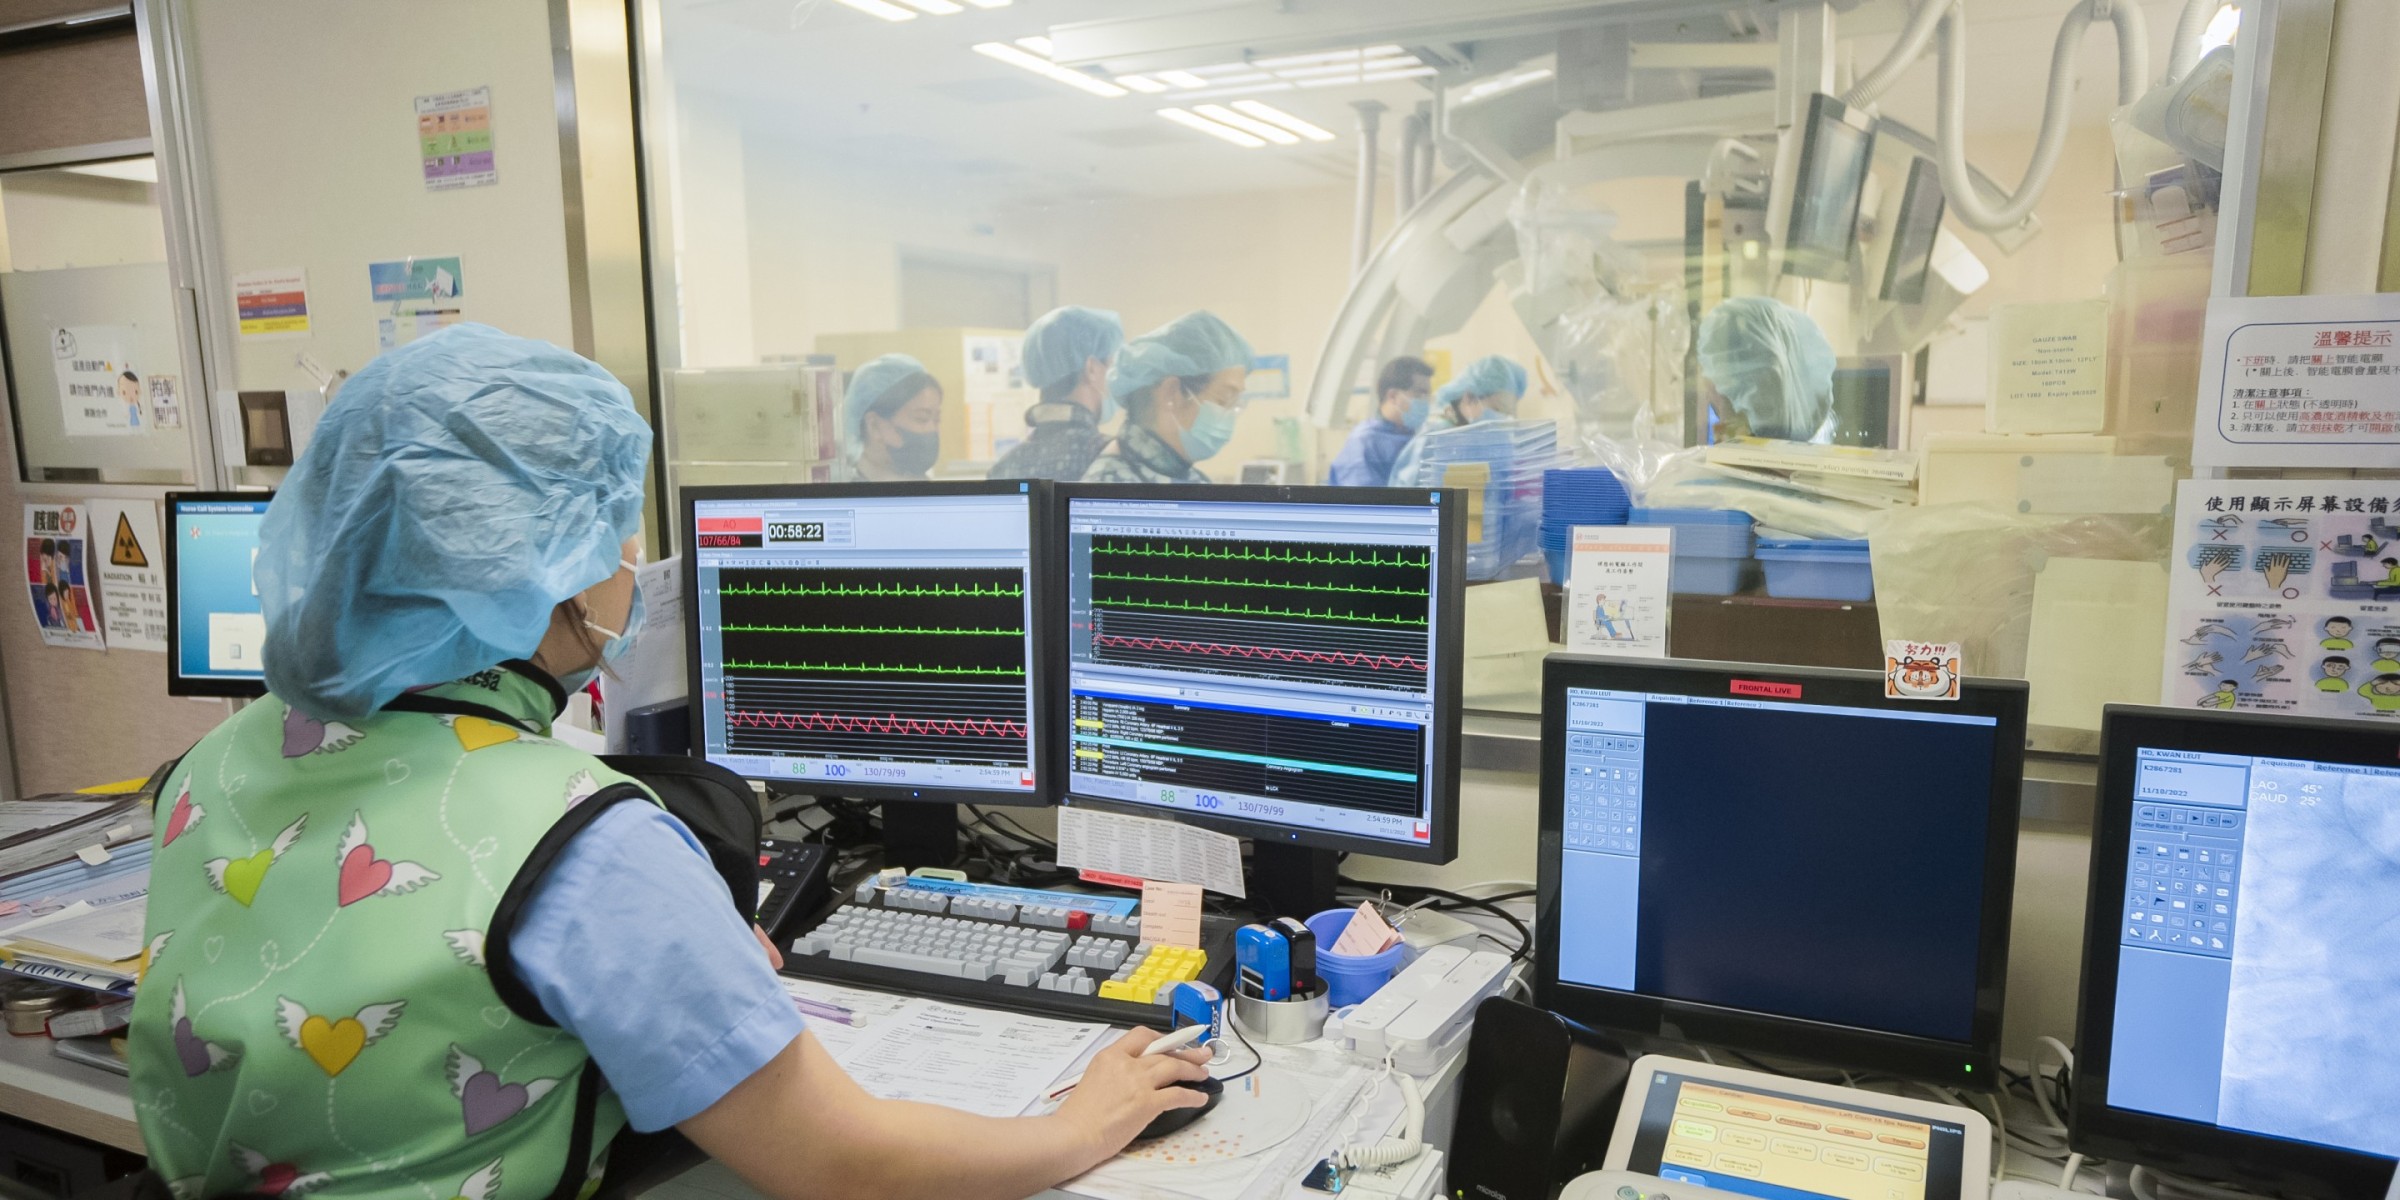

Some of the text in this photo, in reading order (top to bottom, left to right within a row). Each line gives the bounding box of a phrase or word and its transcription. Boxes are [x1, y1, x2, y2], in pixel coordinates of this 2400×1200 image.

[2314, 330, 2392, 346] 溫馨提示
[769, 525, 822, 539] 00:58:22
[699, 535, 741, 546] 107/66/84
[1905, 643, 1946, 655] 努力!!!
[1738, 683, 1792, 695] FRONTAL LIVE
[2141, 750, 2155, 758] HO,
[792, 763, 806, 775] 88
[2144, 765, 2182, 774] K2867281
[2260, 759, 2306, 769] Acquisition
[2316, 764, 2359, 774] Reference
[824, 764, 846, 777] 100
[864, 767, 906, 778] 130/79/99
[2142, 787, 2188, 797] 11/10/2022
[2250, 781, 2322, 794] LAO 45°
[1161, 789, 1175, 803] 88
[1195, 794, 1218, 809] 100
[2250, 792, 2321, 806] CAUD 25°
[1238, 802, 1284, 816] 130/79/99
[1932, 1125, 1962, 1135] PHILIPS
